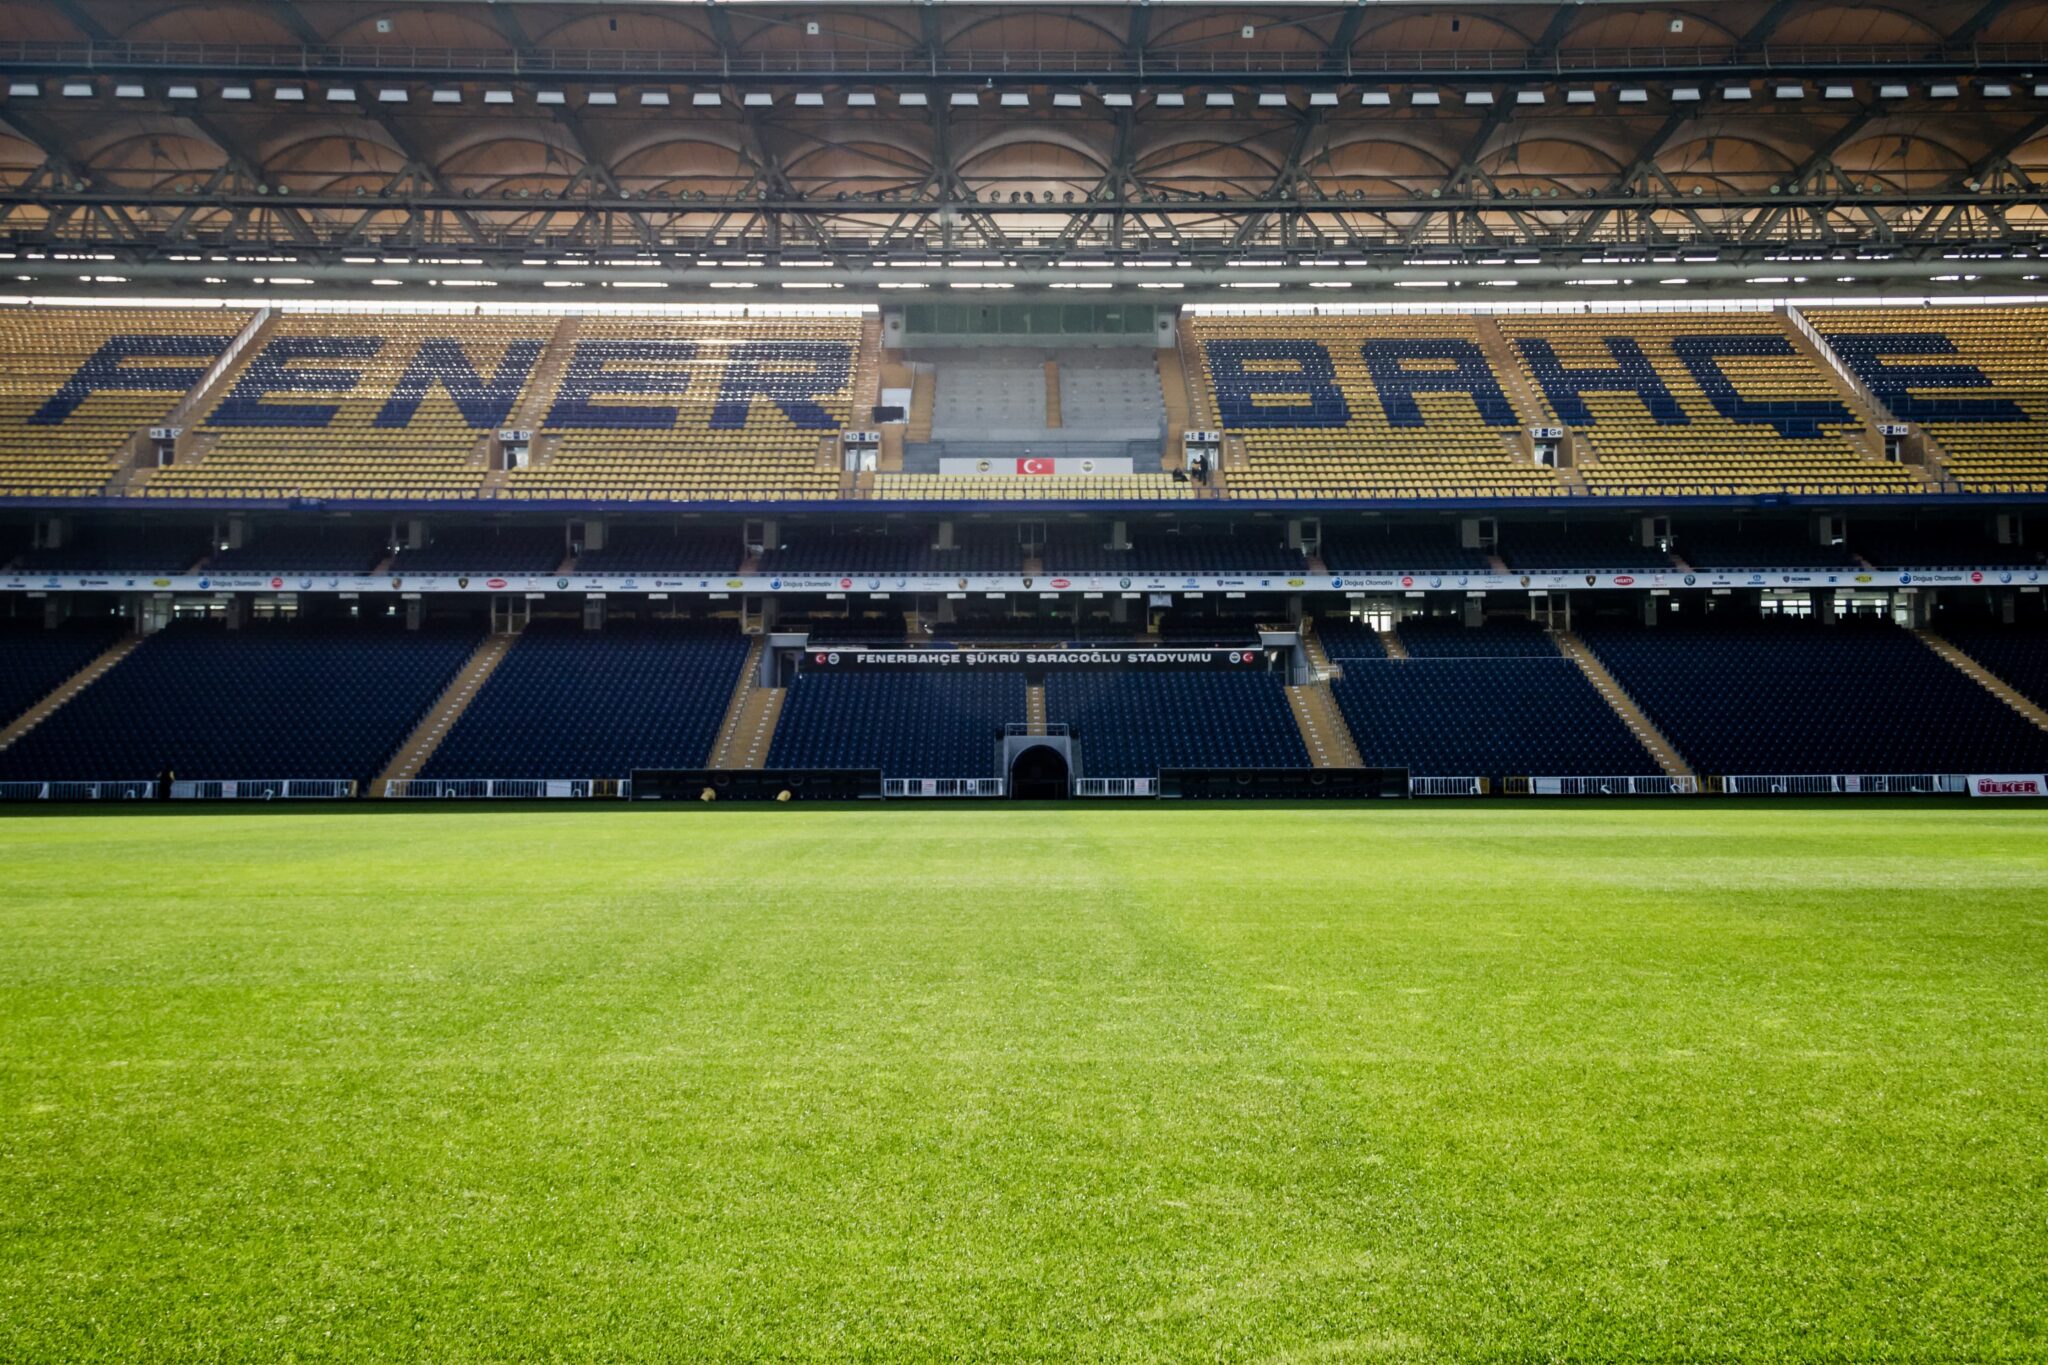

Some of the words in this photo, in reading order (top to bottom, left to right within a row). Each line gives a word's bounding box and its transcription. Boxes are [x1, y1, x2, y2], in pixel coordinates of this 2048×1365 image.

[1344, 579, 1364, 587] Doğuş
[1913, 575, 1933, 583] Doğuş
[857, 654, 960, 666] FENERBAHÇE
[966, 652, 1020, 665] ŞÜKRÜ
[1026, 652, 1121, 663] SARACOĞLU
[1127, 654, 1212, 663] STADYUMU
[1978, 780, 2038, 793] ÜLKER
